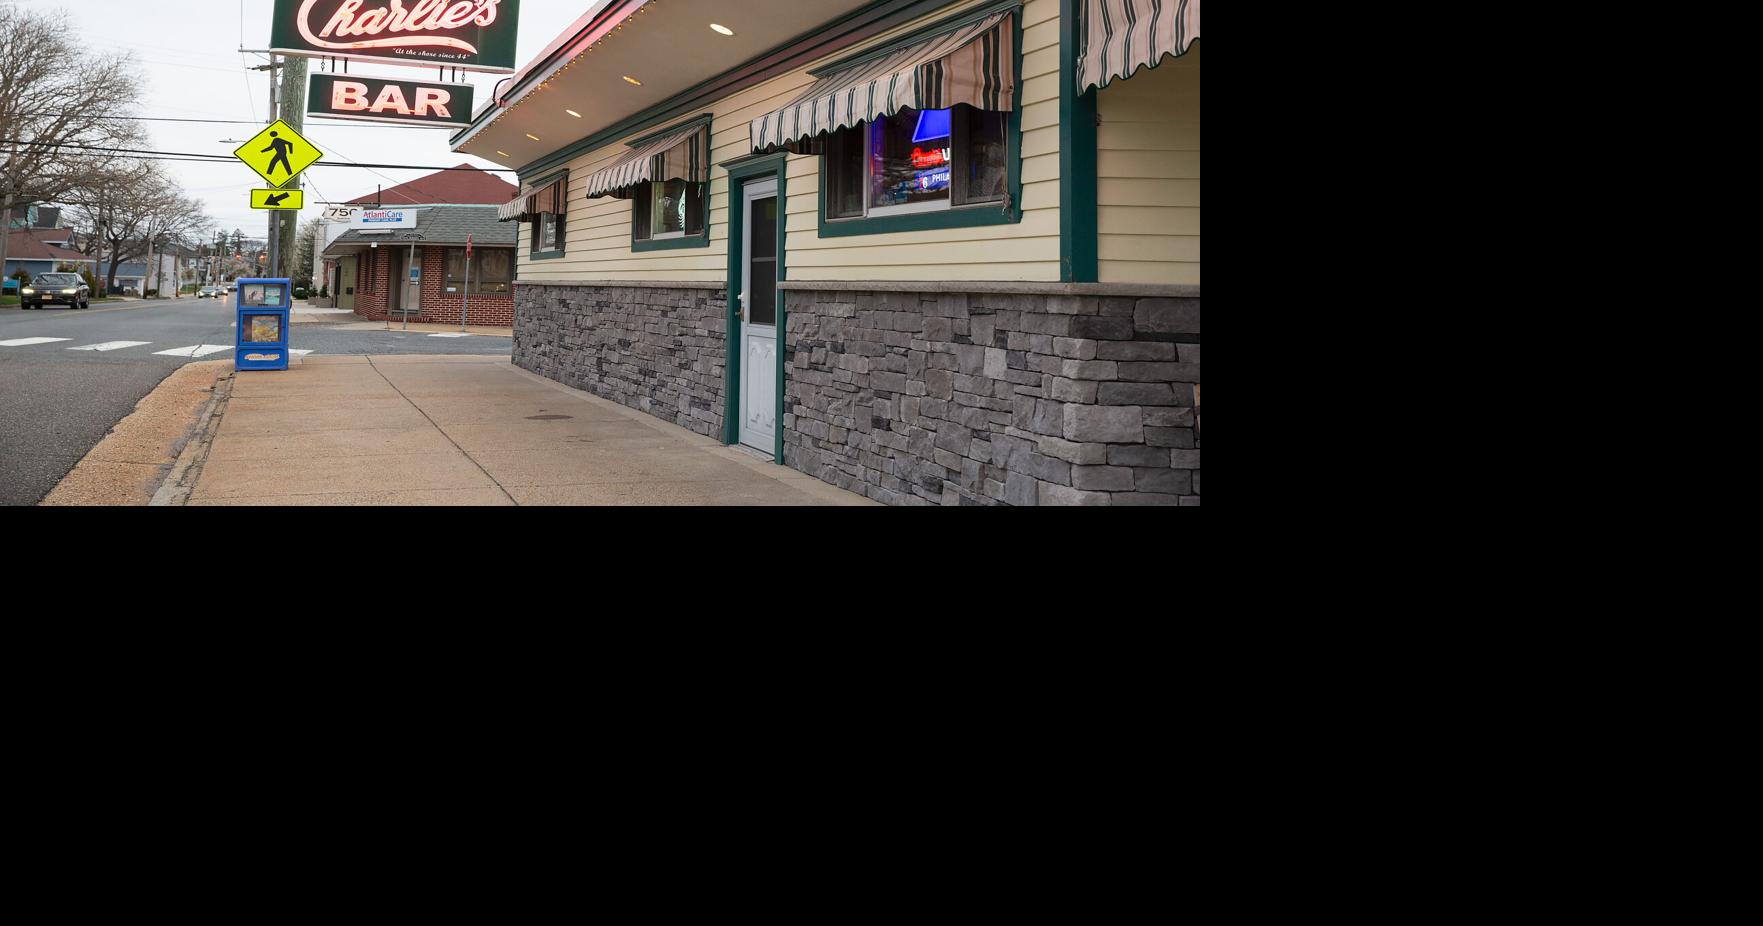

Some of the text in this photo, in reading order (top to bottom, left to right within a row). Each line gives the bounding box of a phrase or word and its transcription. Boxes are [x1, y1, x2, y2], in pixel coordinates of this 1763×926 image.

[418, 50, 438, 58] shore
[331, 80, 452, 118] BAR
[363, 210, 403, 219] AtlantiCare
